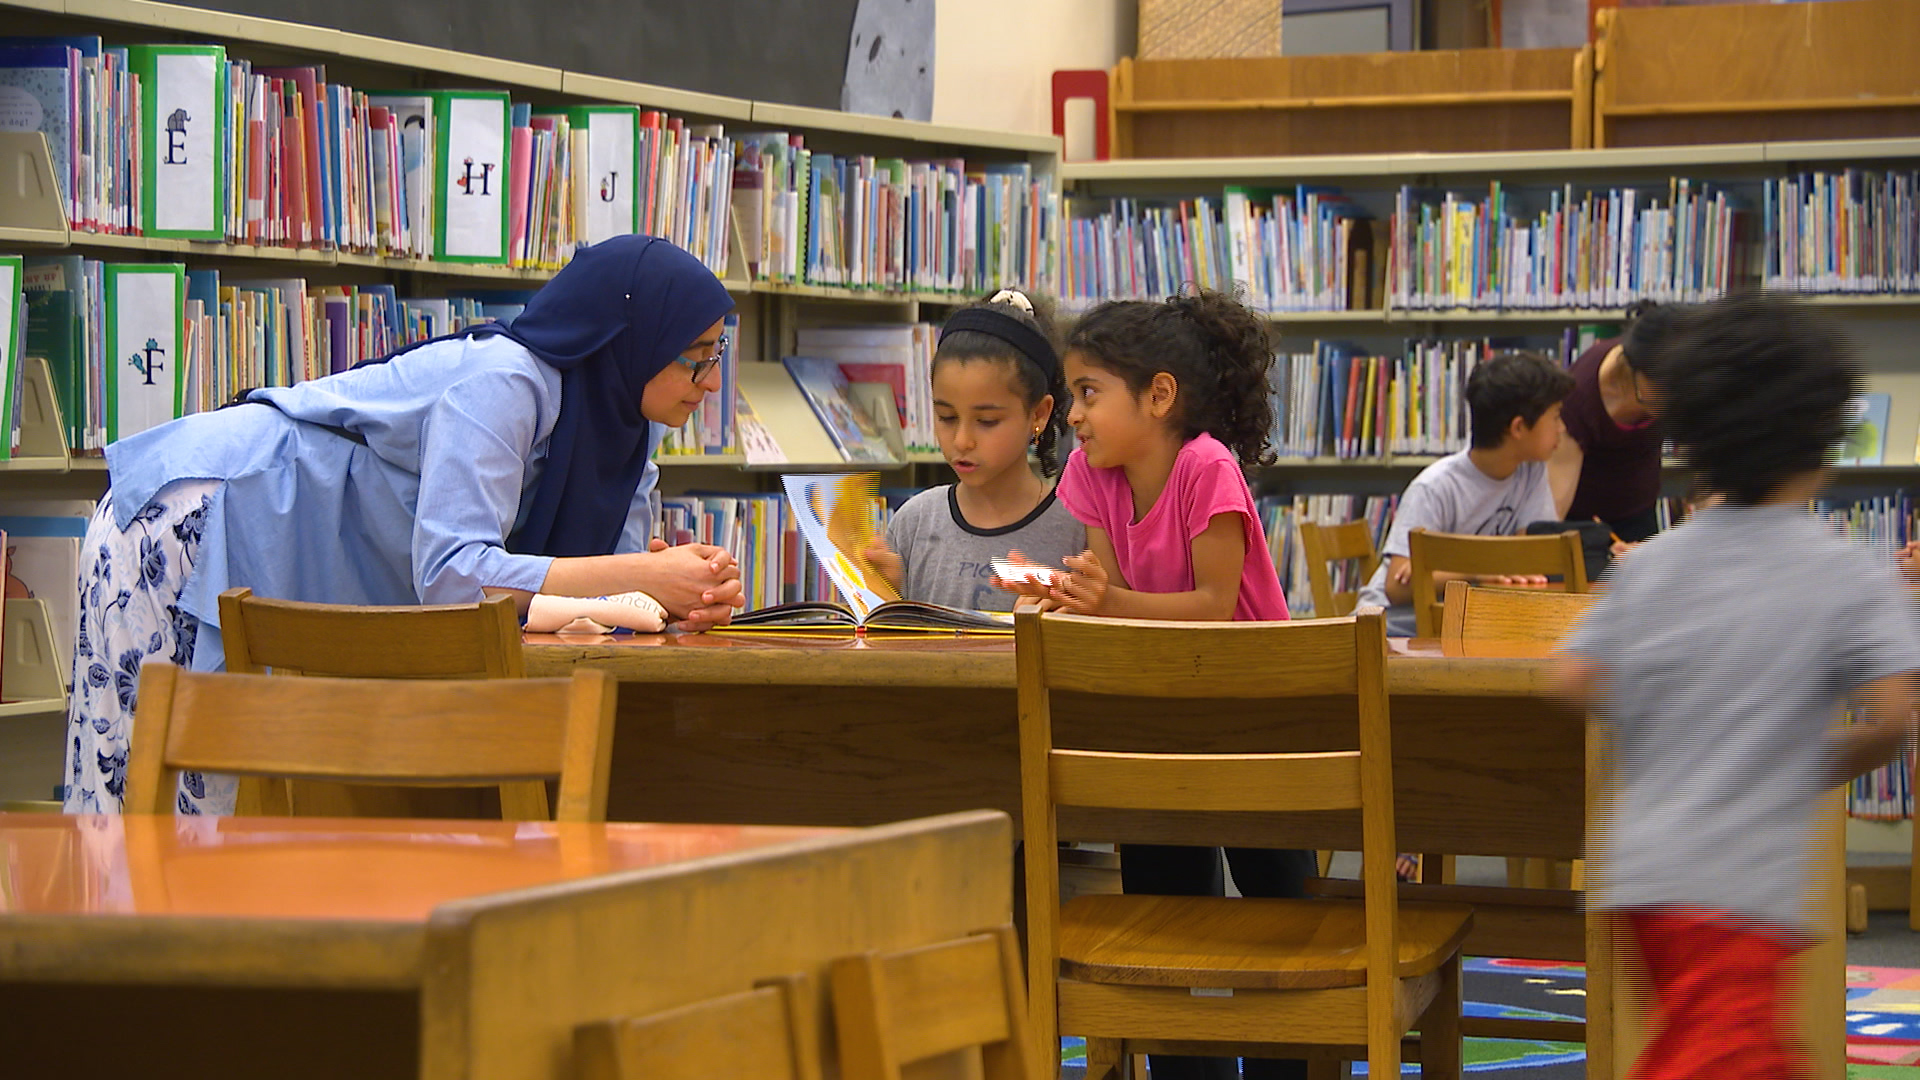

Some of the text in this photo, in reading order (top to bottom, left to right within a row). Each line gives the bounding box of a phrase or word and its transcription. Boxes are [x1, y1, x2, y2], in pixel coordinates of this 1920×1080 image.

[164, 128, 187, 165] E
[462, 161, 493, 196] H
[600, 171, 618, 203] J
[142, 348, 165, 386] F
